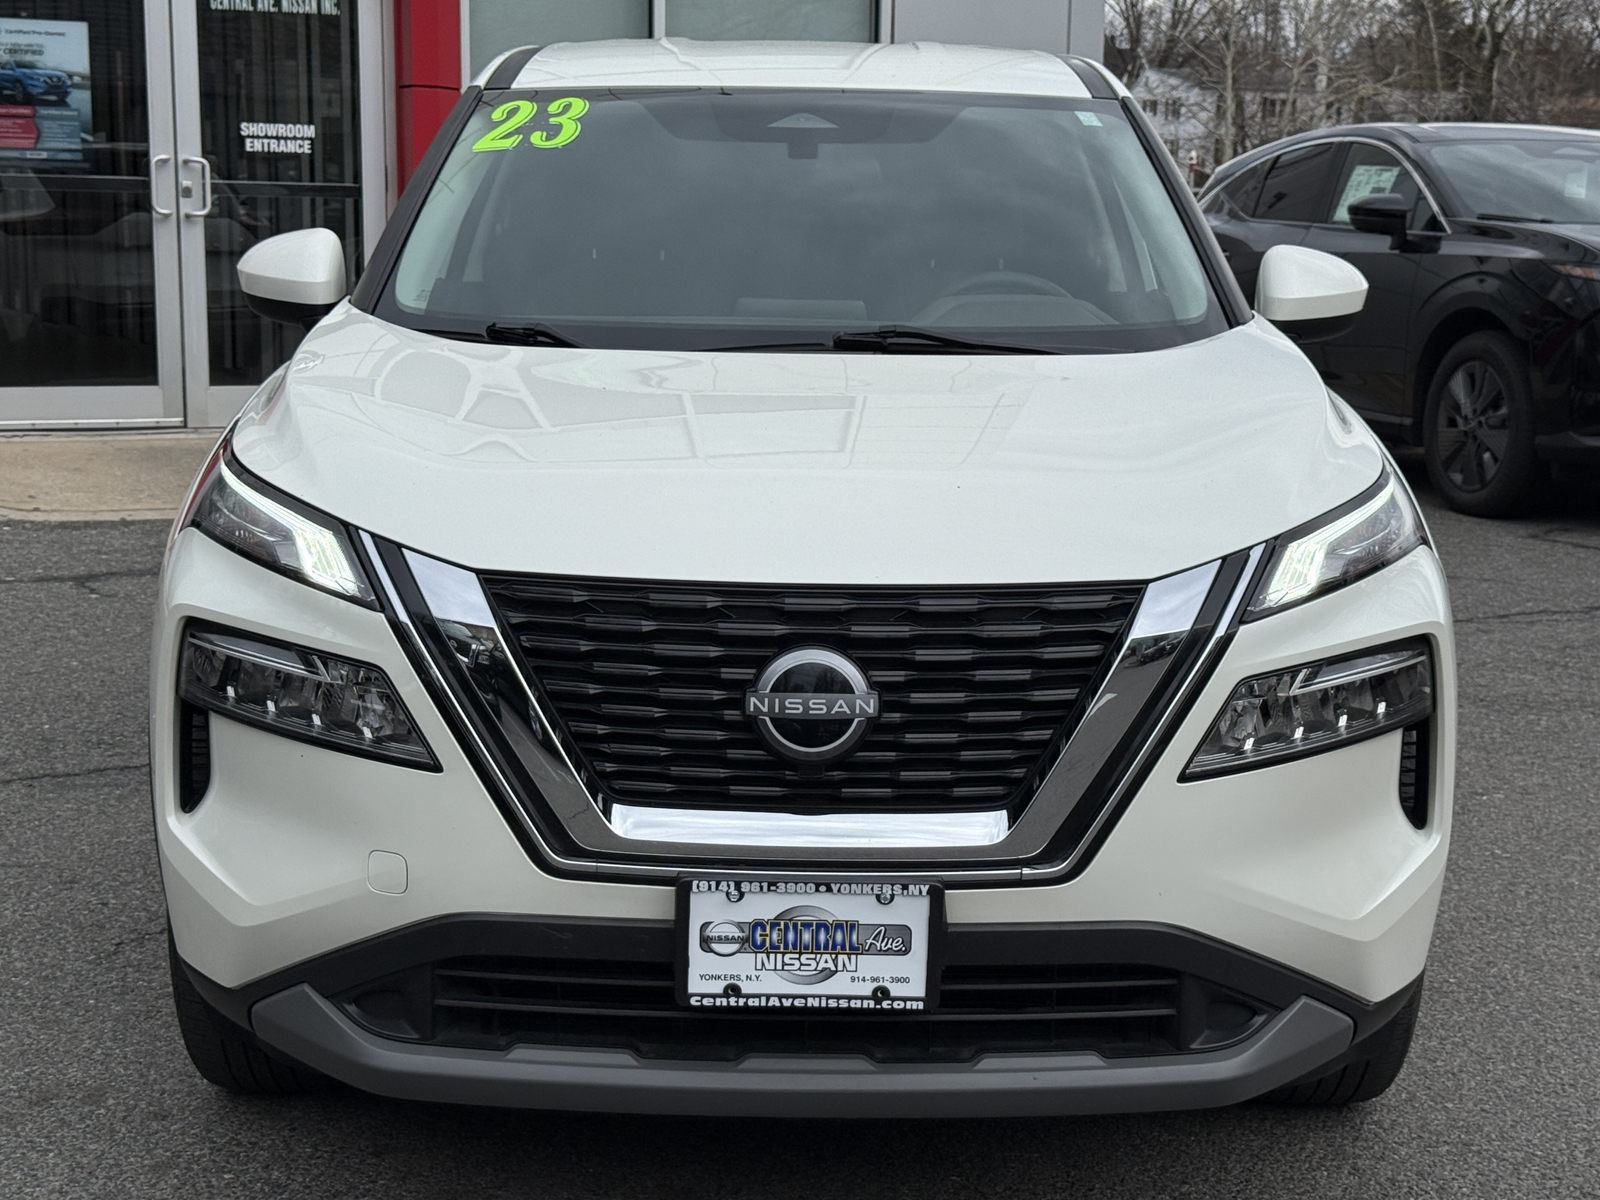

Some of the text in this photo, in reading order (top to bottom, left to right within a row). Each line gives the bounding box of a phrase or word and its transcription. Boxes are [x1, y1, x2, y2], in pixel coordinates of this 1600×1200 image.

[240, 121, 316, 139] SHOWROOM
[472, 97, 590, 153] 23
[245, 138, 312, 154] ENTRANCE
[750, 697, 874, 714] NISSAN
[741, 882, 816, 894] 961-3900
[750, 919, 863, 953] CENTRAL
[865, 925, 907, 952] Ave.
[755, 953, 858, 972] NISSAN
[699, 973, 762, 983] YONKERS, N.Y.
[850, 975, 911, 984] 914-961-3900
[690, 996, 924, 1010] CentralAveNissan.com
